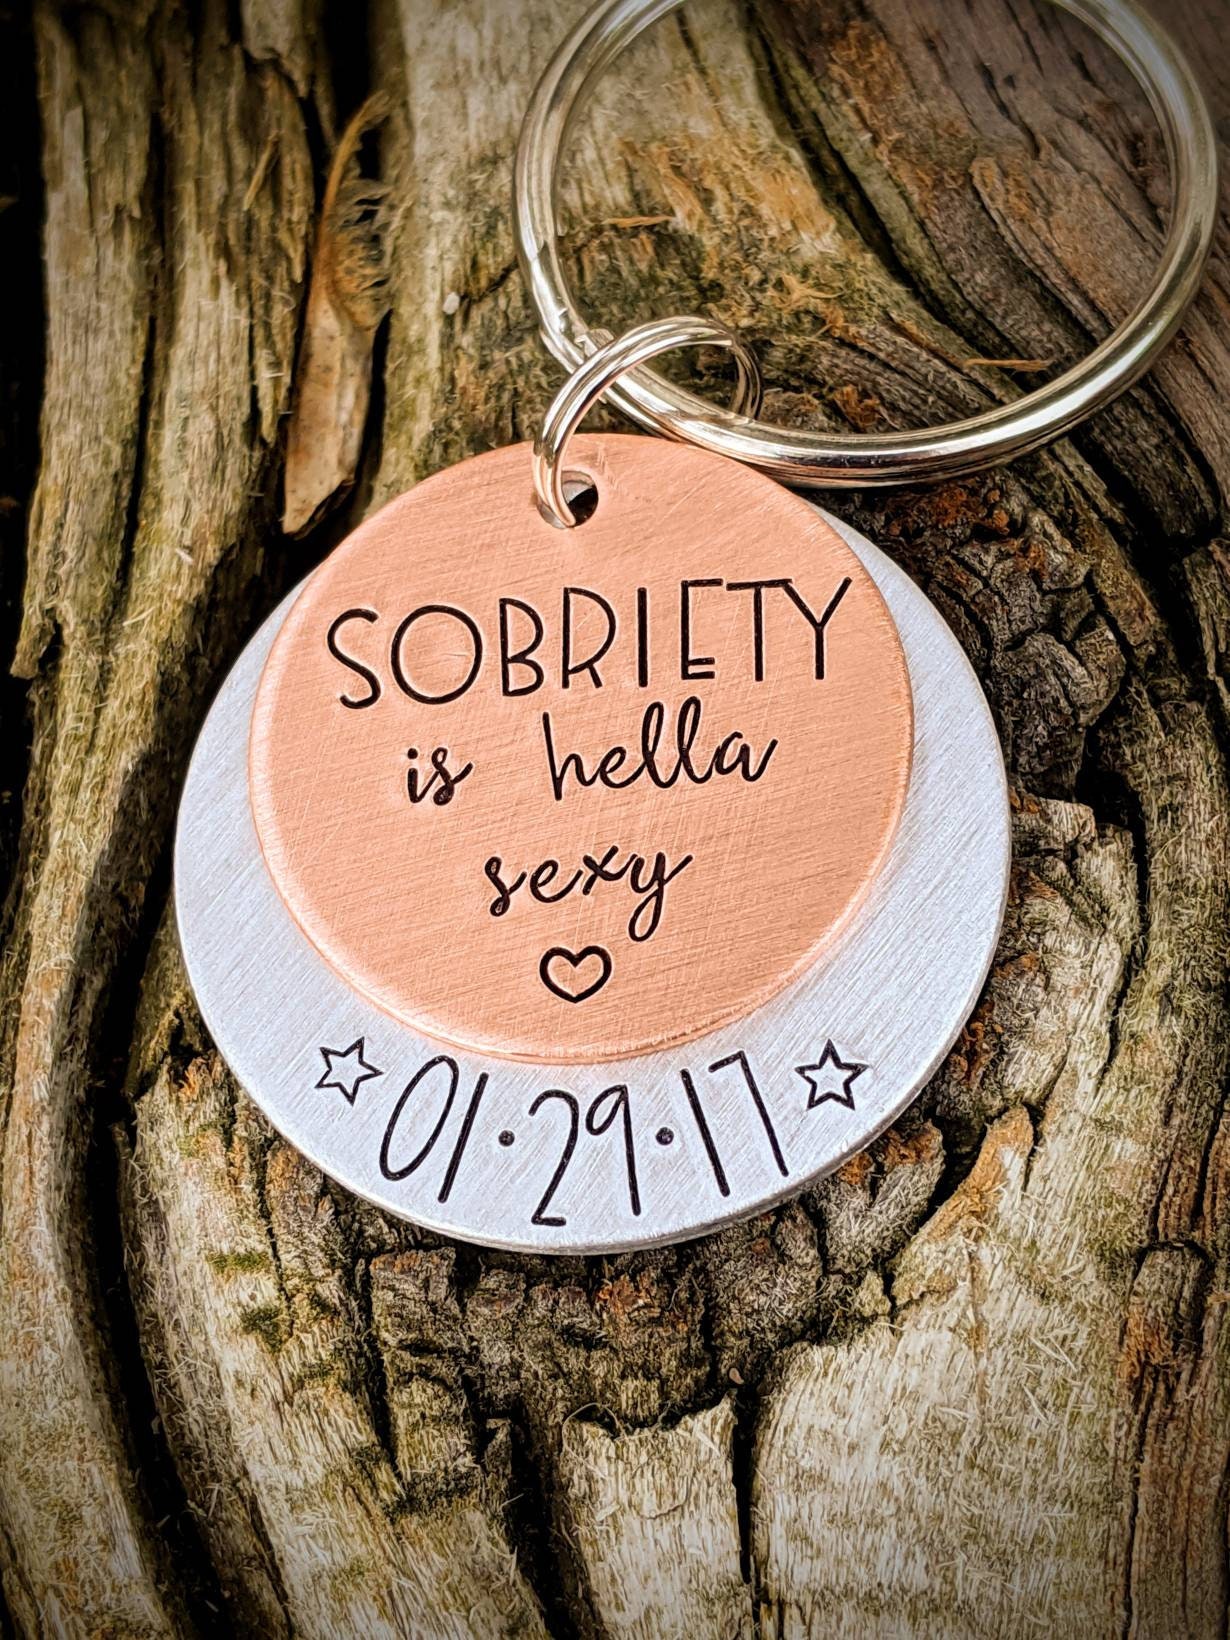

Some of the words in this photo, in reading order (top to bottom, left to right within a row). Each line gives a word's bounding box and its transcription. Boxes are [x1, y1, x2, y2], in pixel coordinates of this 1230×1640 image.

[326, 576, 853, 710] SOBRIETY
[406, 745, 474, 807] is
[541, 695, 779, 801] hella
[484, 844, 693, 943] sexy
